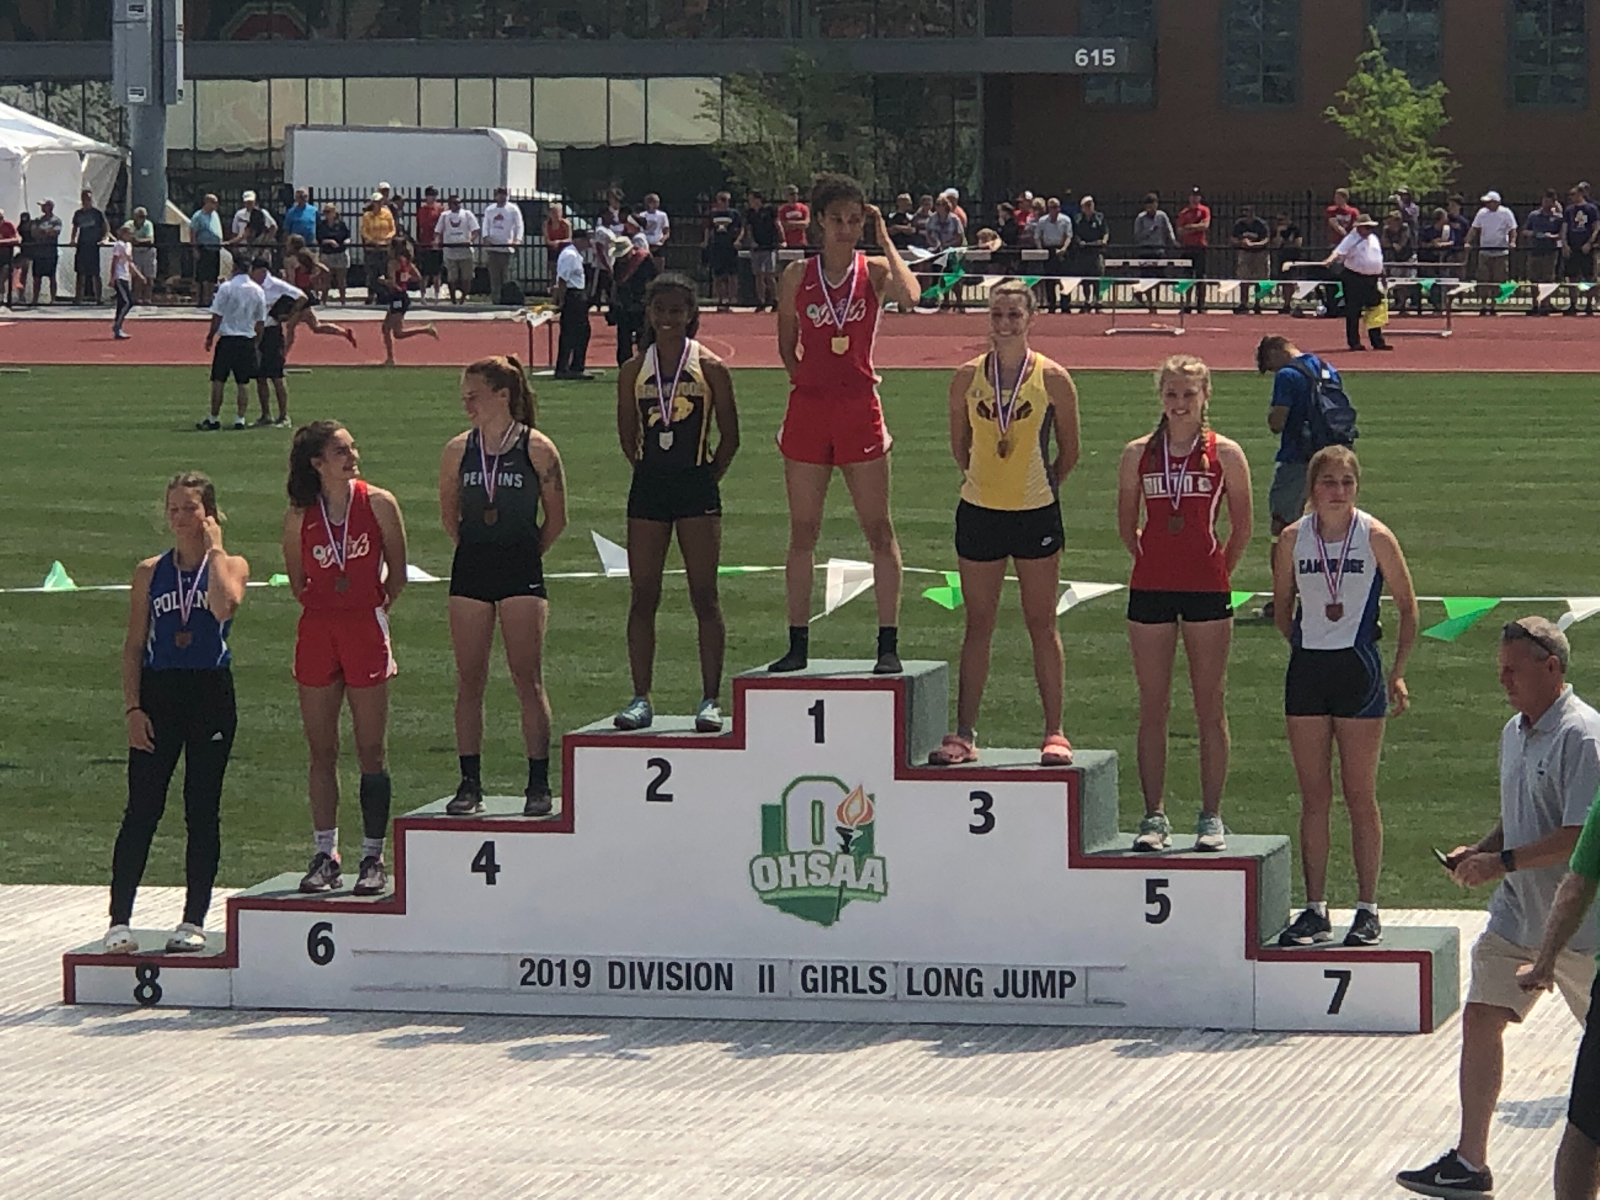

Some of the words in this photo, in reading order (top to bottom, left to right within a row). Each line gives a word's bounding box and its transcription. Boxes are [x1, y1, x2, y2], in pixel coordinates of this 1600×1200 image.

[1075, 48, 1116, 67] 615
[463, 471, 524, 489] PEINS
[1143, 475, 1194, 495] MILTN
[1299, 558, 1365, 575] CAMRDGE
[153, 589, 208, 618] POLAN
[808, 700, 824, 743] 1
[646, 758, 673, 802] 2
[970, 791, 995, 834] 3
[471, 841, 500, 885] 4
[750, 849, 889, 896] OHSAA
[1146, 879, 1170, 924] 5
[307, 922, 334, 965] 6
[134, 963, 163, 1006] 8
[520, 958, 591, 989] 2019
[608, 960, 733, 991] DIVISION
[758, 965, 775, 994] II
[800, 964, 888, 995] GIRLS
[907, 968, 984, 998] LONG
[994, 969, 1077, 1000] JUMP
[1324, 970, 1351, 1014] 7
